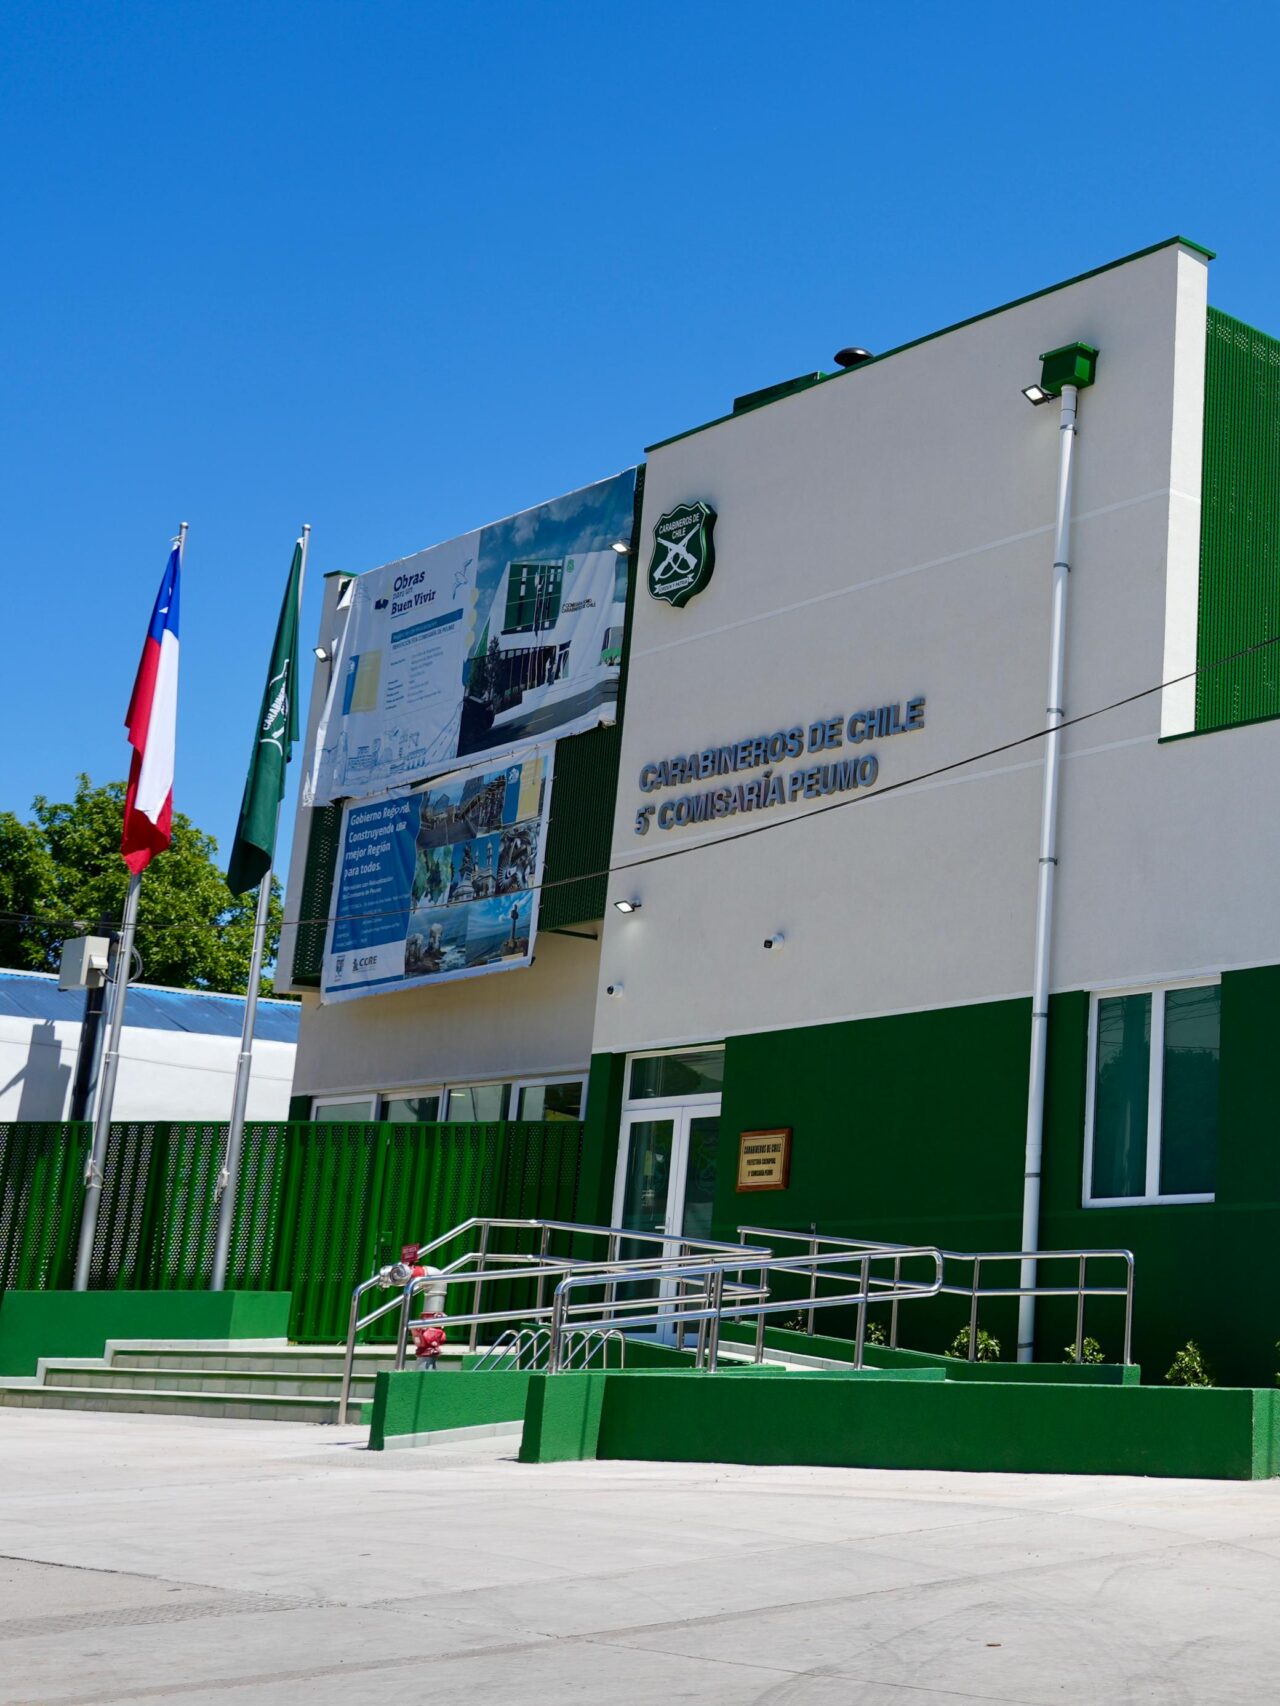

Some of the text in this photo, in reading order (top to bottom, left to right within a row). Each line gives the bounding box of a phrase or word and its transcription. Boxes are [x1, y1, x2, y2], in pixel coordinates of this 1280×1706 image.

[658, 512, 700, 534] CARABINEROS DE
[671, 527, 686, 539] CHILE
[393, 570, 425, 592] Obras
[391, 589, 437, 615] Buen Vivir
[639, 697, 926, 792] CARABINEROS DE CHILE
[657, 770, 786, 830] COMISARÍA
[787, 753, 880, 802] PEUMO
[350, 801, 411, 826] Gobierno Regional
[396, 821, 408, 832] una
[345, 840, 391, 861] mejor Región
[343, 866, 360, 881] para
